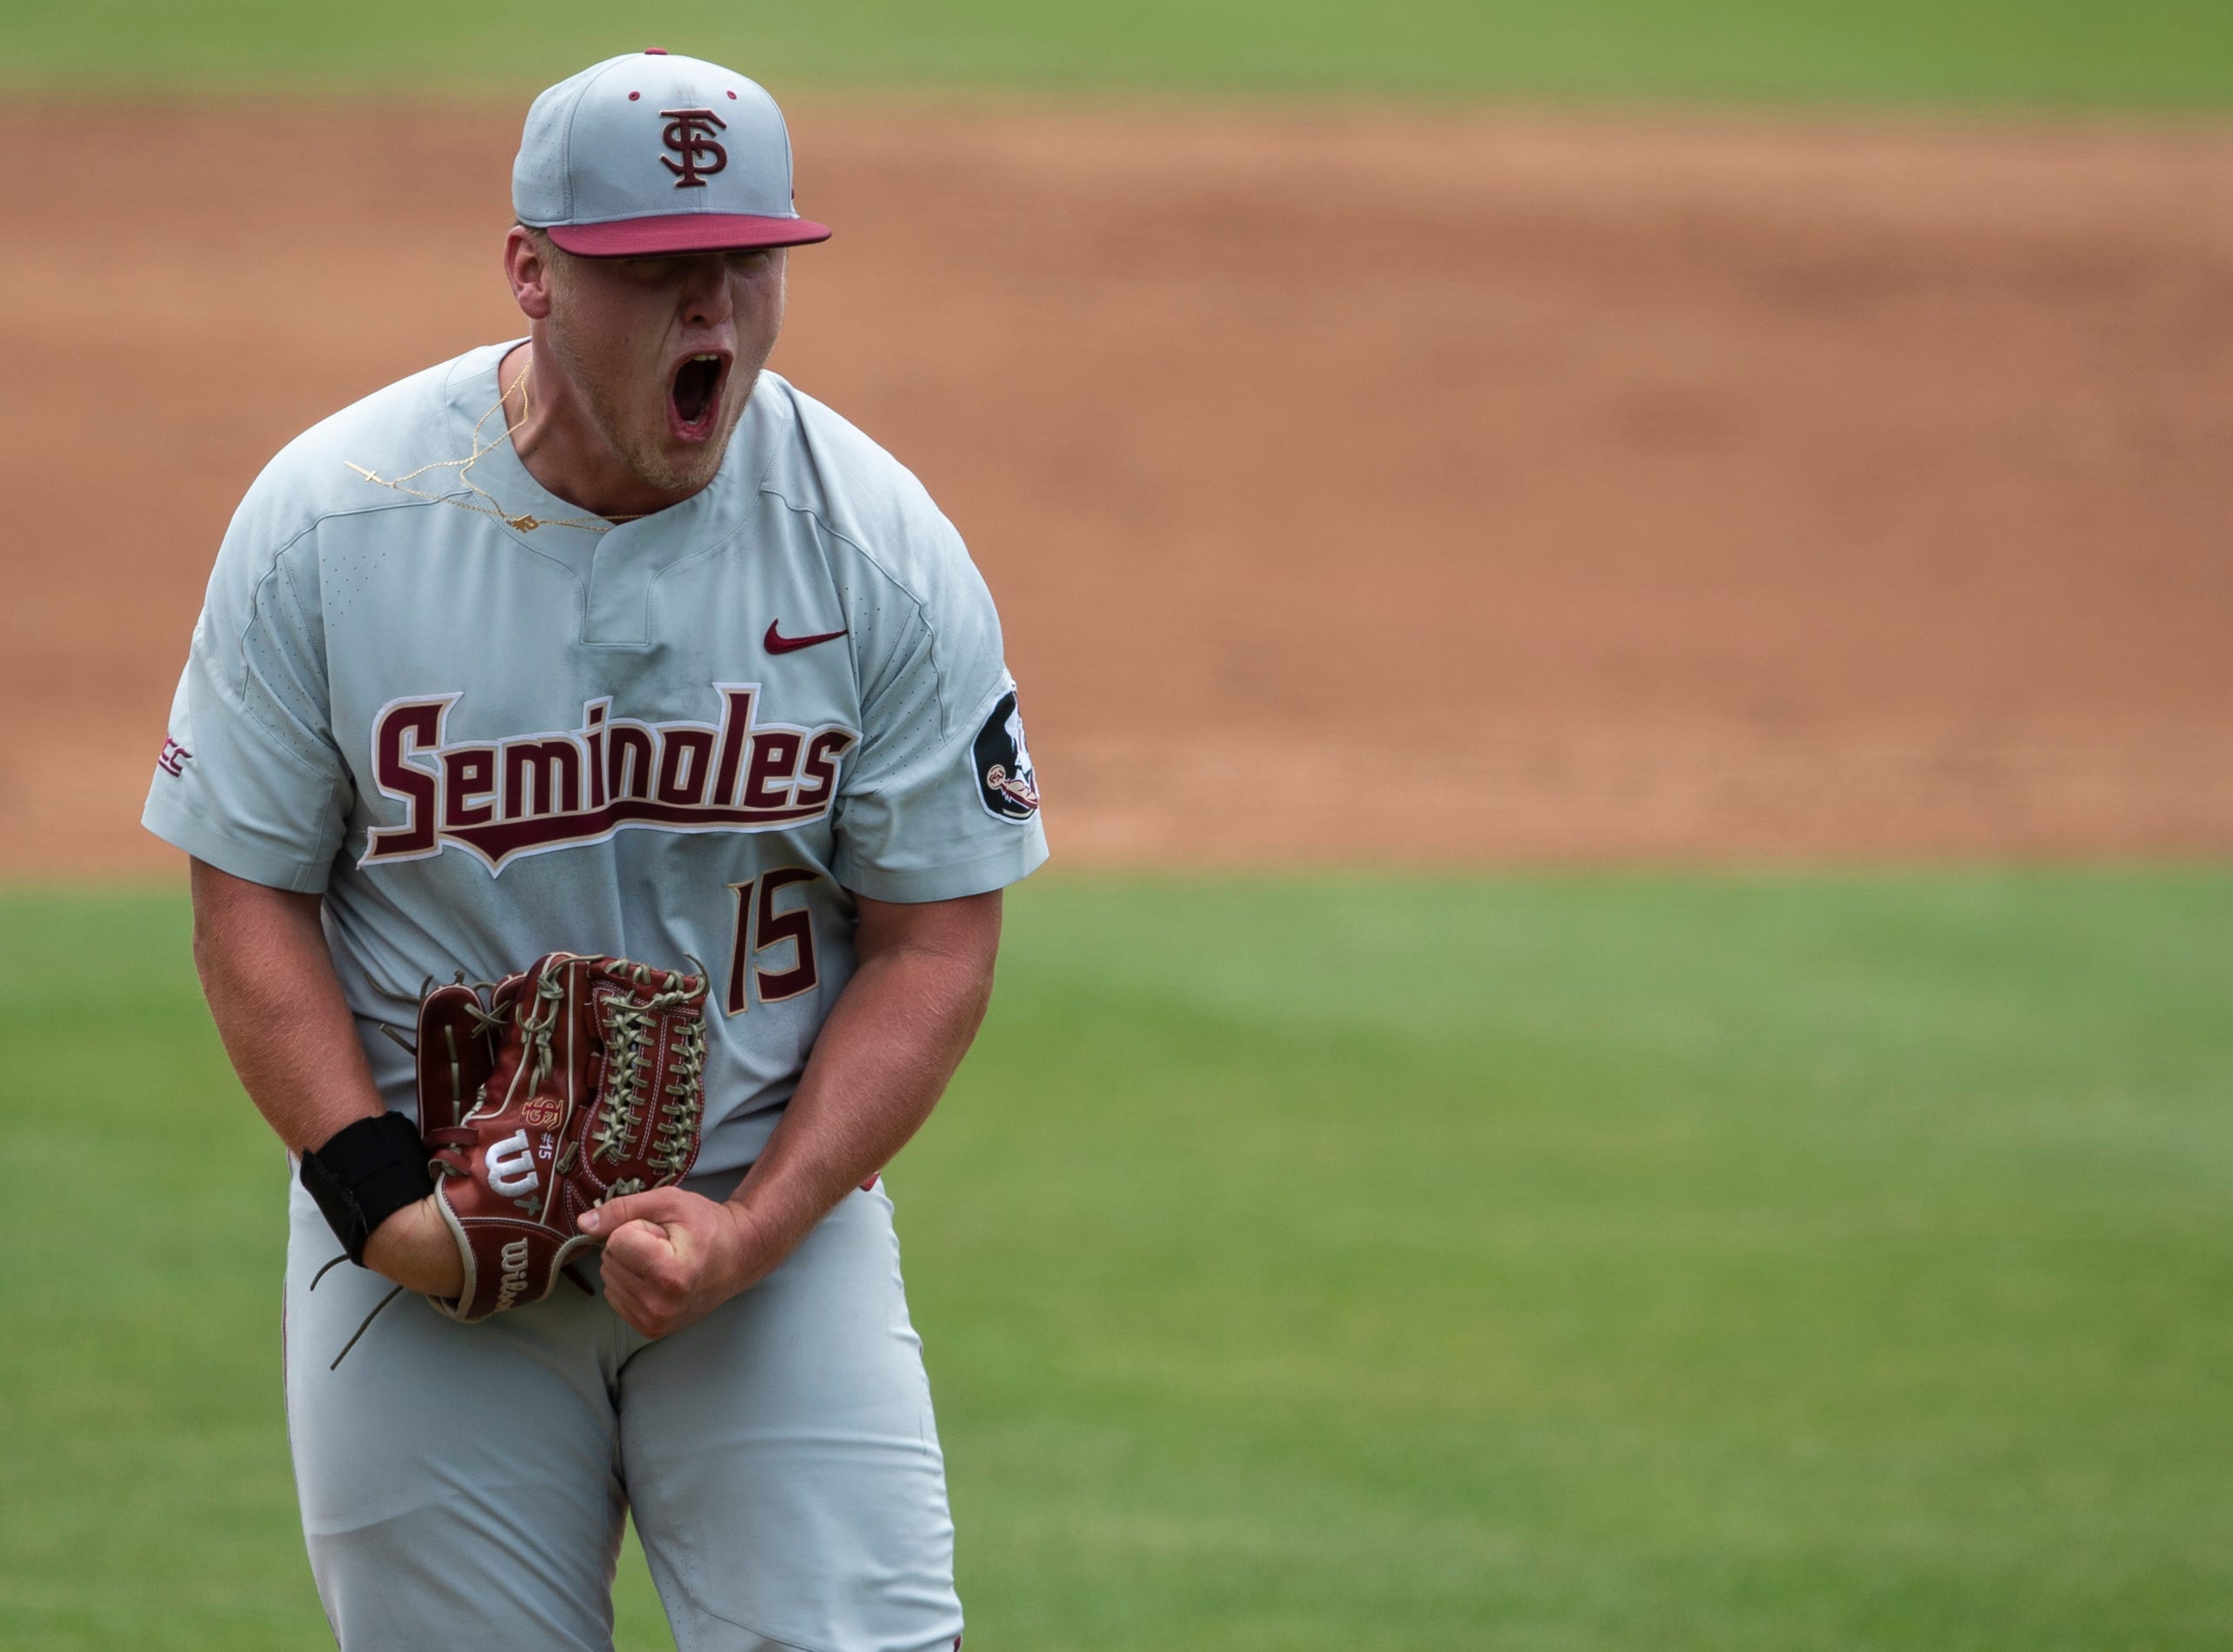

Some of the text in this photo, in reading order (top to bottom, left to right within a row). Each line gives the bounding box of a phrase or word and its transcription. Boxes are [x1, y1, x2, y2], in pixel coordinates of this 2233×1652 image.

[157, 736, 193, 778] CC
[357, 682, 863, 879] Seminoles
[727, 866, 827, 1017] 15
[485, 1129, 539, 1197] W
